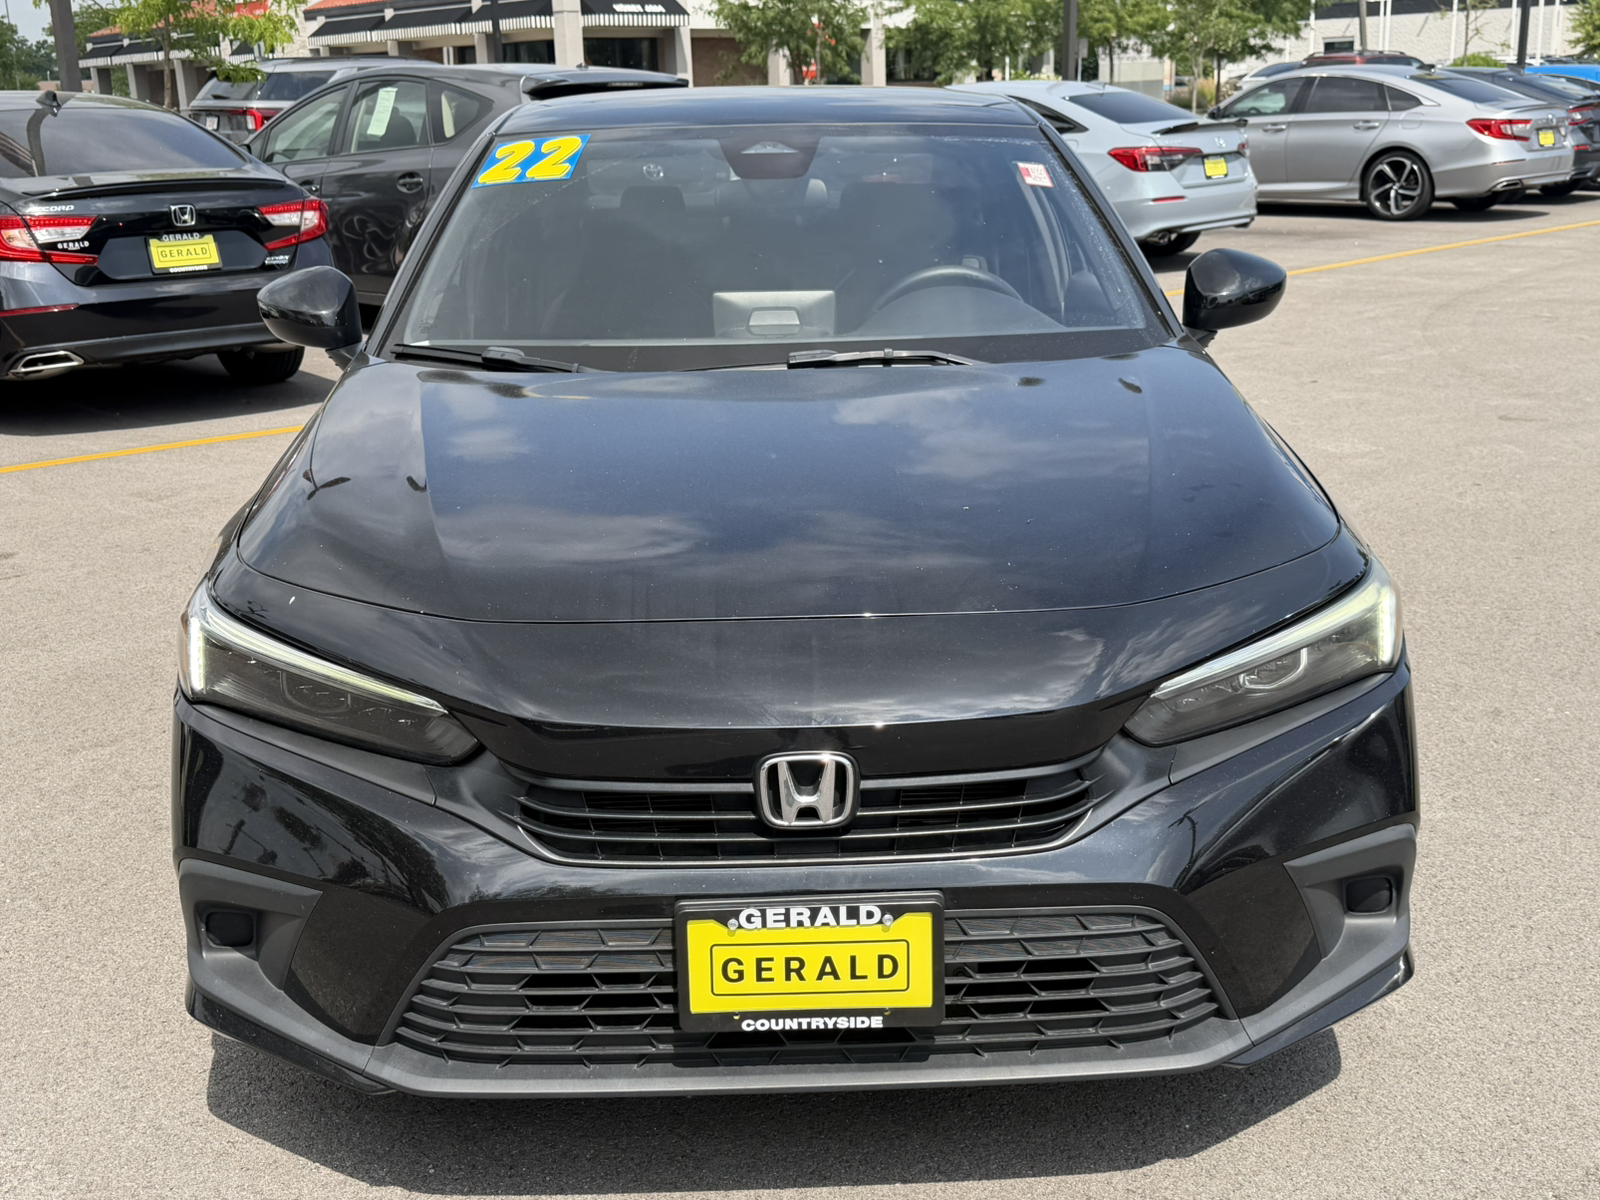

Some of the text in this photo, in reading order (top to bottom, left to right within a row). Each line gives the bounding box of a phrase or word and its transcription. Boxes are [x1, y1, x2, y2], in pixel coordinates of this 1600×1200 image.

[477, 136, 583, 185] 22
[57, 240, 90, 250] GERALD
[162, 232, 200, 242] GERALD
[160, 246, 208, 259] GERALD
[738, 904, 882, 930] GERALD
[721, 953, 900, 984] GERALD
[741, 1015, 884, 1032] COUNTRYSIDE
